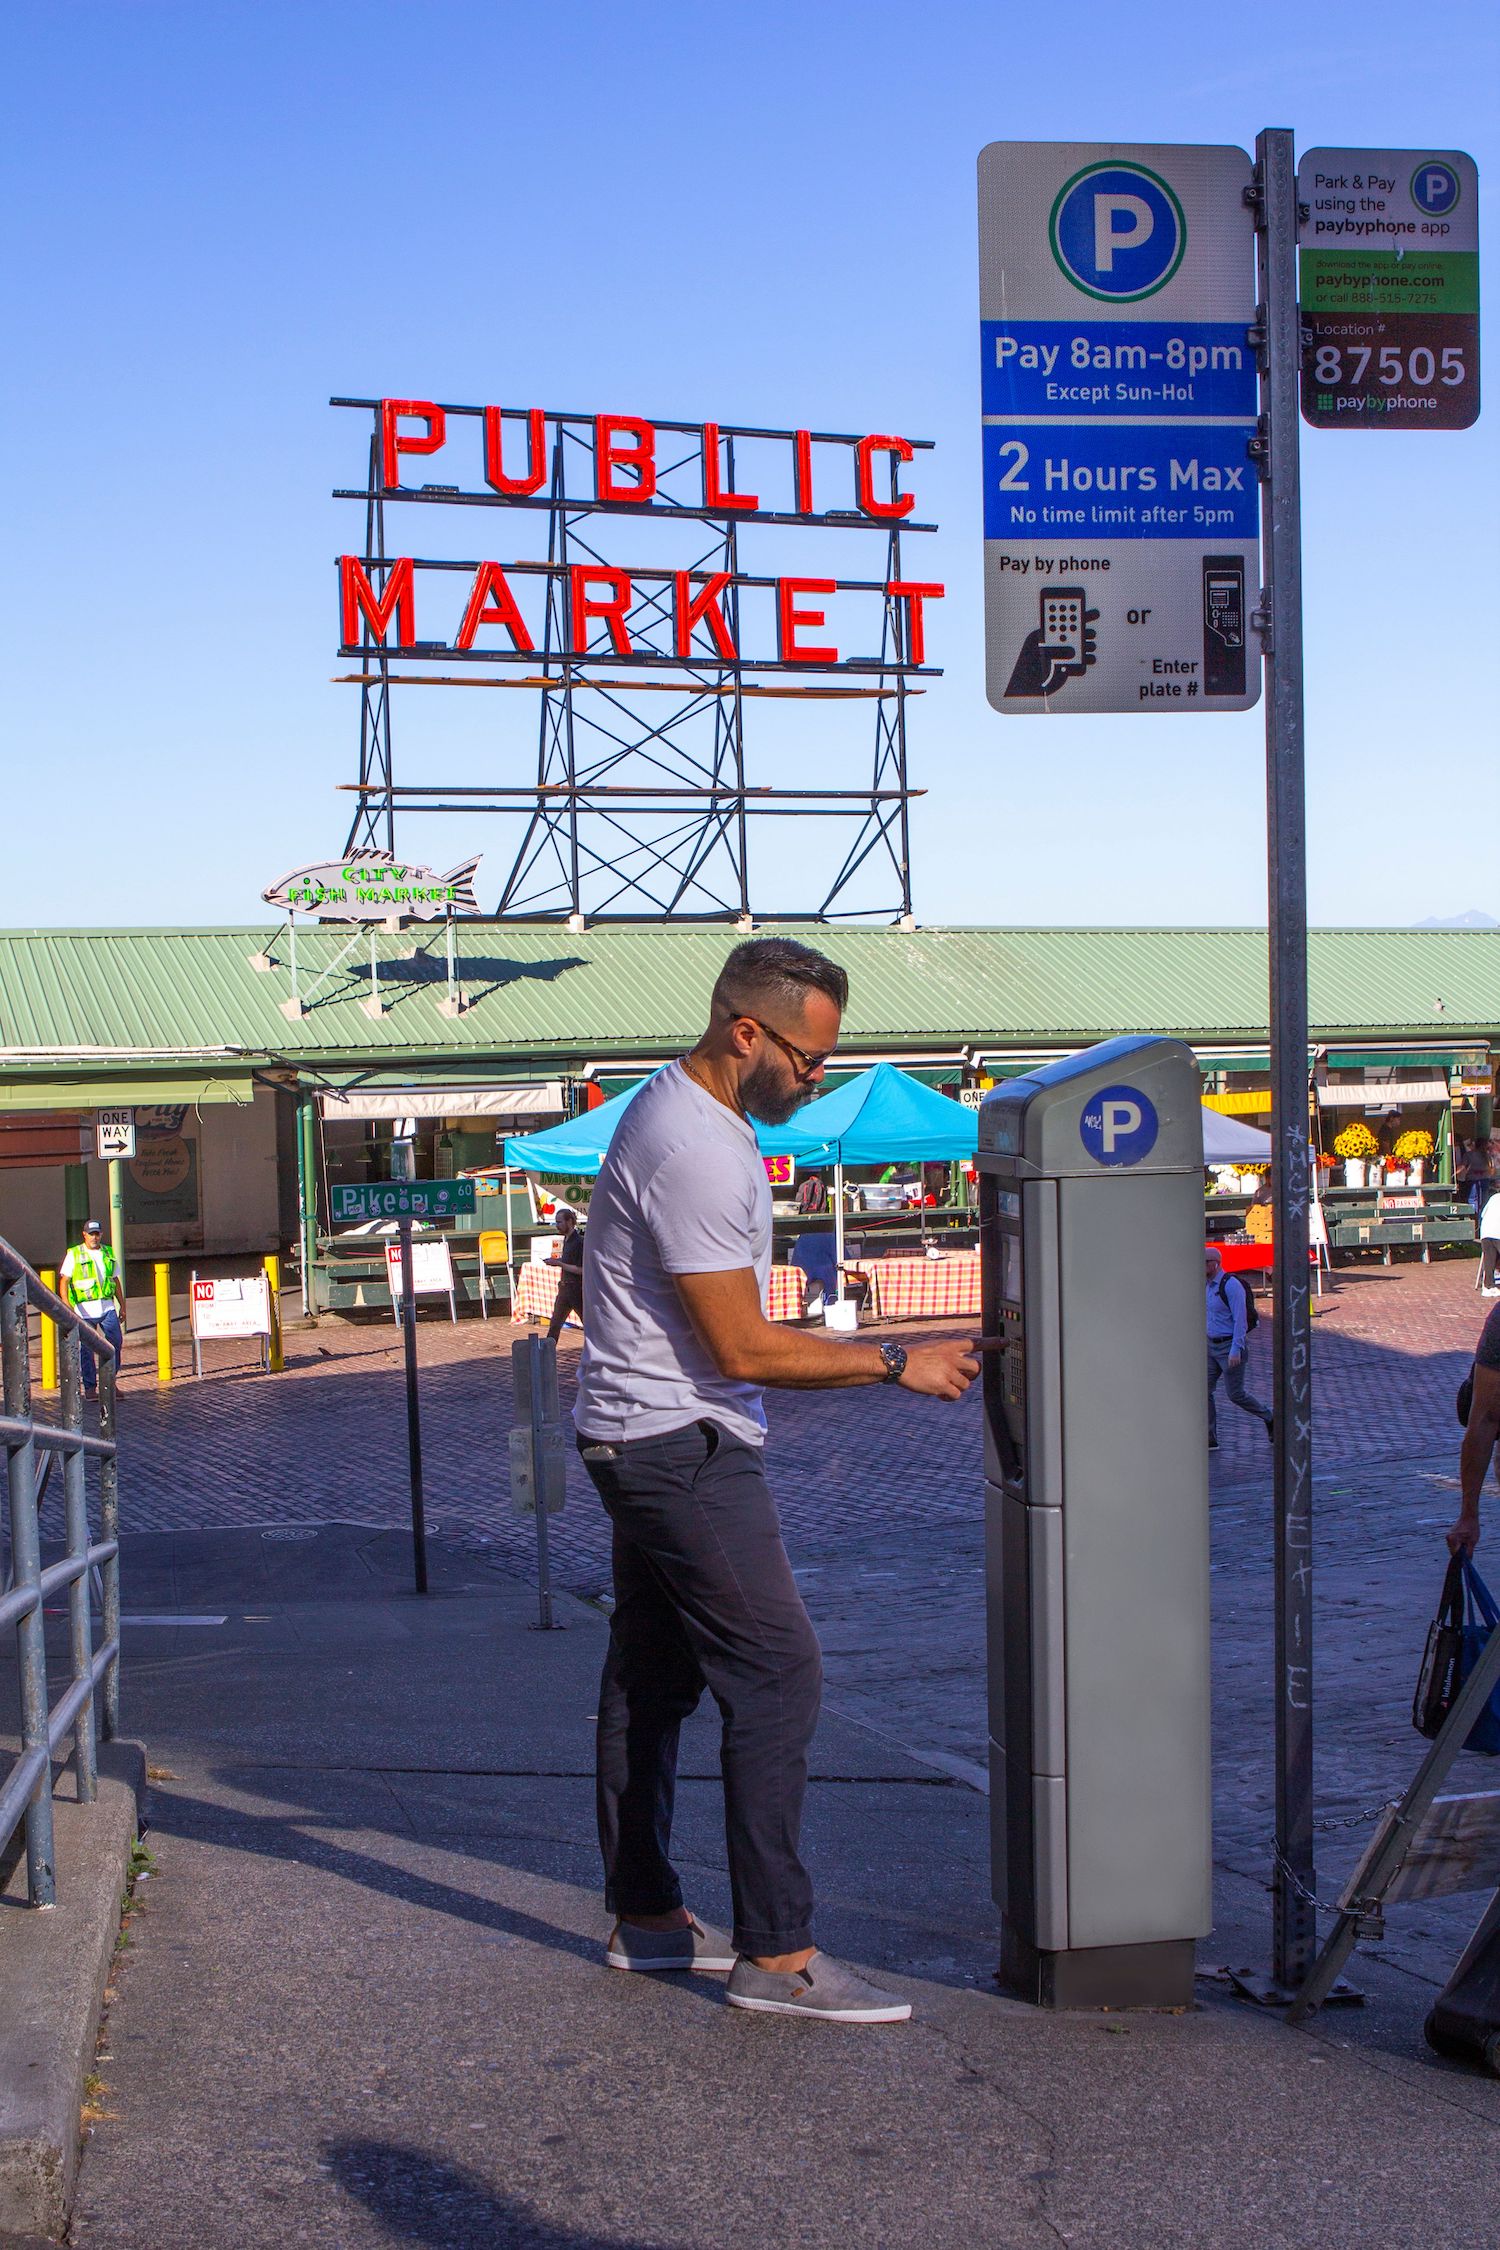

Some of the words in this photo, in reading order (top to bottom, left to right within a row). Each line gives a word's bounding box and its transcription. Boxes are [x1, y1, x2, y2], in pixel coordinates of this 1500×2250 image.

[1315, 175, 1348, 189] Park
[1353, 176, 1363, 189] &
[1369, 176, 1395, 192] Pay
[1427, 174, 1448, 202] P
[1315, 196, 1355, 213] using
[1360, 197, 1385, 211] the
[1095, 193, 1154, 272] P
[1315, 218, 1416, 235] paybyphone
[1421, 223, 1450, 236] app
[1315, 273, 1445, 288] paybyphone.com
[1316, 294, 1328, 302] or
[1330, 293, 1348, 302] call
[1352, 293, 1437, 304] 888-515-7275
[1316, 323, 1374, 335] Location
[1378, 324, 1386, 332] #
[995, 337, 1060, 376] Pay
[1071, 338, 1243, 377] 8am-8pm
[1314, 346, 1466, 386] 87505
[1046, 383, 1110, 404] Except
[1116, 384, 1194, 400] Sun-Hol
[1337, 394, 1437, 411] paybyphone
[380, 399, 915, 519] PUBLIC
[999, 441, 1029, 491] 2
[1045, 458, 1157, 491] Hours
[1170, 459, 1244, 491] Max
[1010, 506, 1036, 523] No
[1043, 506, 1085, 522] time
[1092, 506, 1136, 522] limit
[1141, 506, 1188, 523] after
[1194, 506, 1234, 526] 5pm
[1000, 556, 1029, 574] Pay
[1035, 556, 1054, 574] by
[1059, 556, 1110, 574] phone
[340, 555, 945, 666] MARKET
[1127, 609, 1151, 625] or
[1153, 659, 1198, 674] Enter
[1139, 681, 1181, 699] plate
[1187, 682, 1198, 696] #
[342, 867, 406, 882] CITY
[288, 887, 345, 902] FISH
[356, 886, 457, 902] MARKET
[963, 1092, 984, 1103] ONE
[102, 1112, 129, 1124] ONE
[1102, 1101, 1142, 1152] P
[102, 1126, 130, 1138] WAY
[458, 1184, 472, 1196] 60
[342, 1188, 396, 1215] Pike
[197, 1284, 213, 1298] NO
